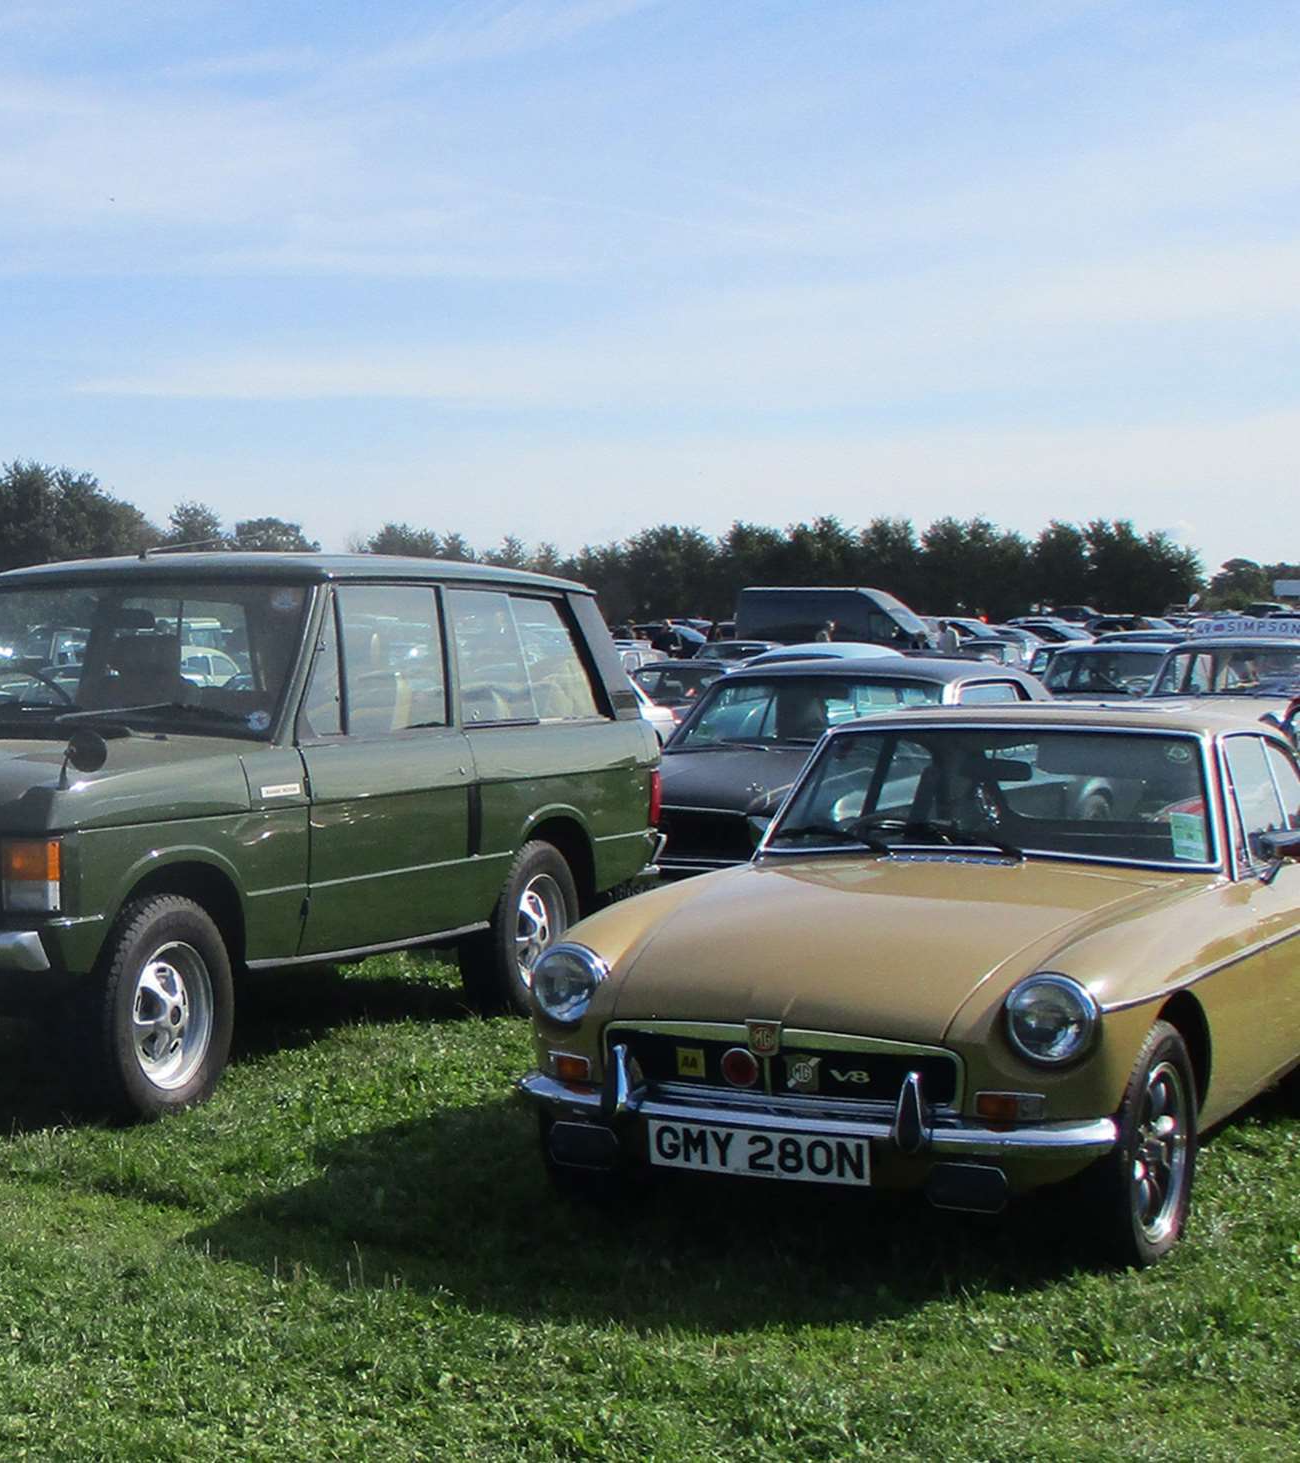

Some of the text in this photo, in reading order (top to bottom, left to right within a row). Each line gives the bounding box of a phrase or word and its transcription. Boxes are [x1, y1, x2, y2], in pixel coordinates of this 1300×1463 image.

[830, 1069, 871, 1084] V8
[655, 1125, 865, 1180] GMY 280N
